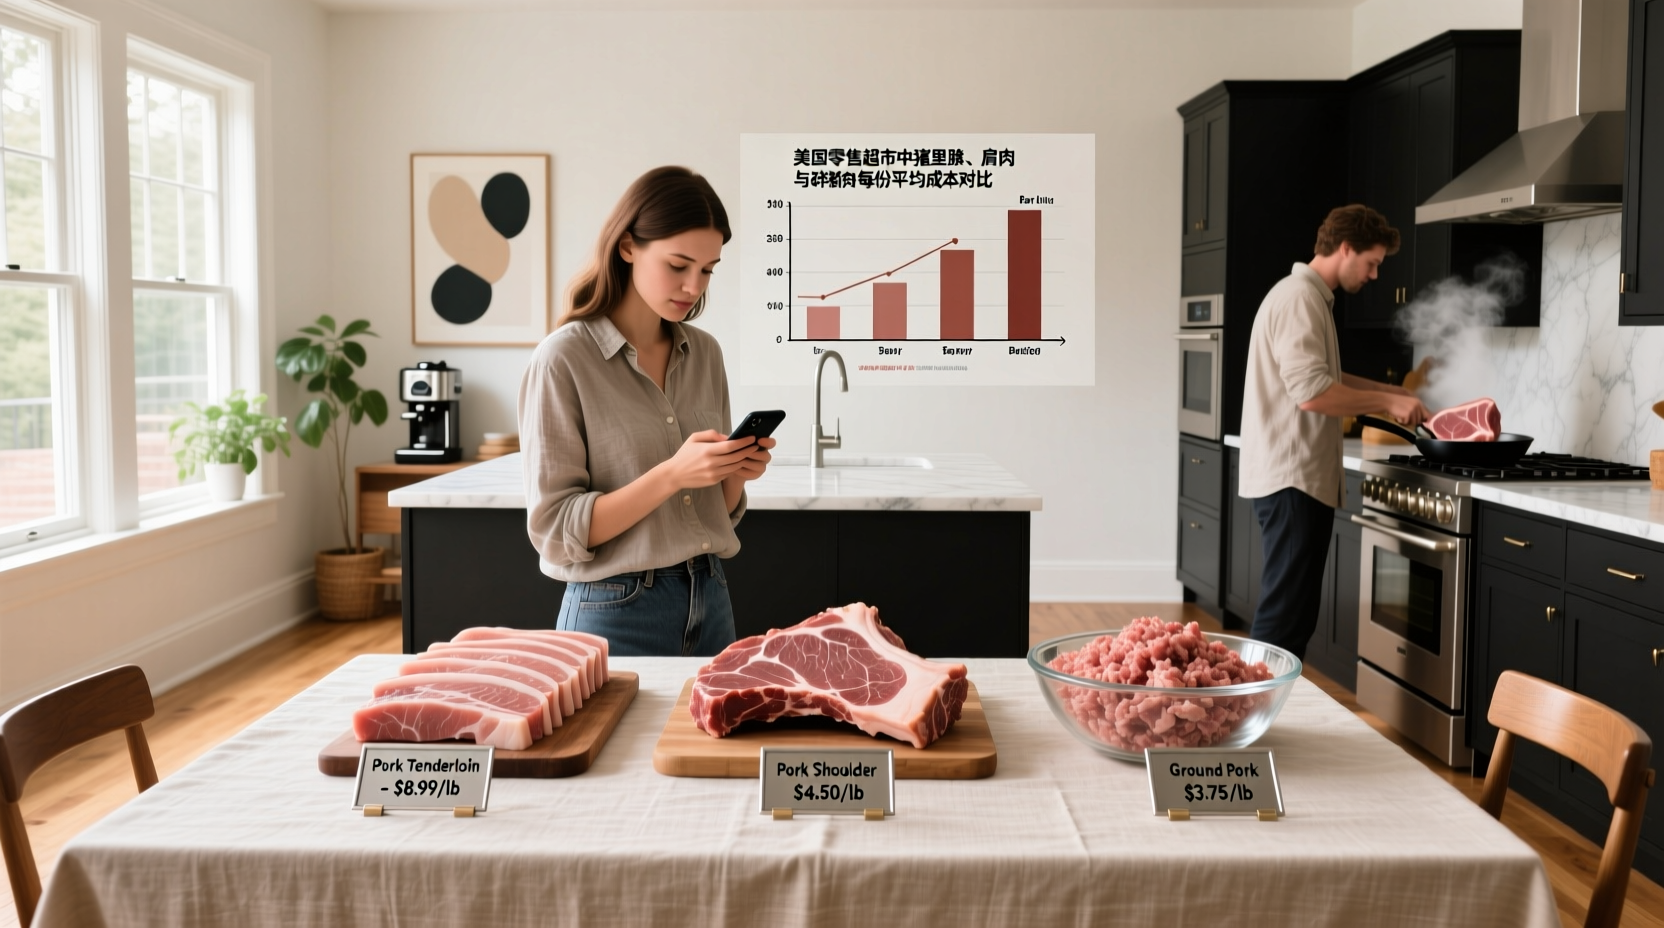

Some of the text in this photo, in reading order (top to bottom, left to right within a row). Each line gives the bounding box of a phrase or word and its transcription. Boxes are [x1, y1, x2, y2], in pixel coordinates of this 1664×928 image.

[372, 758, 480, 773] Pork Tenderloin
[777, 761, 877, 777] Pork Shoulder
[1169, 762, 1259, 777] Ground Pork
[394, 779, 460, 799] $8.99/lb
[793, 783, 864, 803] $4.50/lb
[1184, 783, 1254, 803] $3.75/lb
